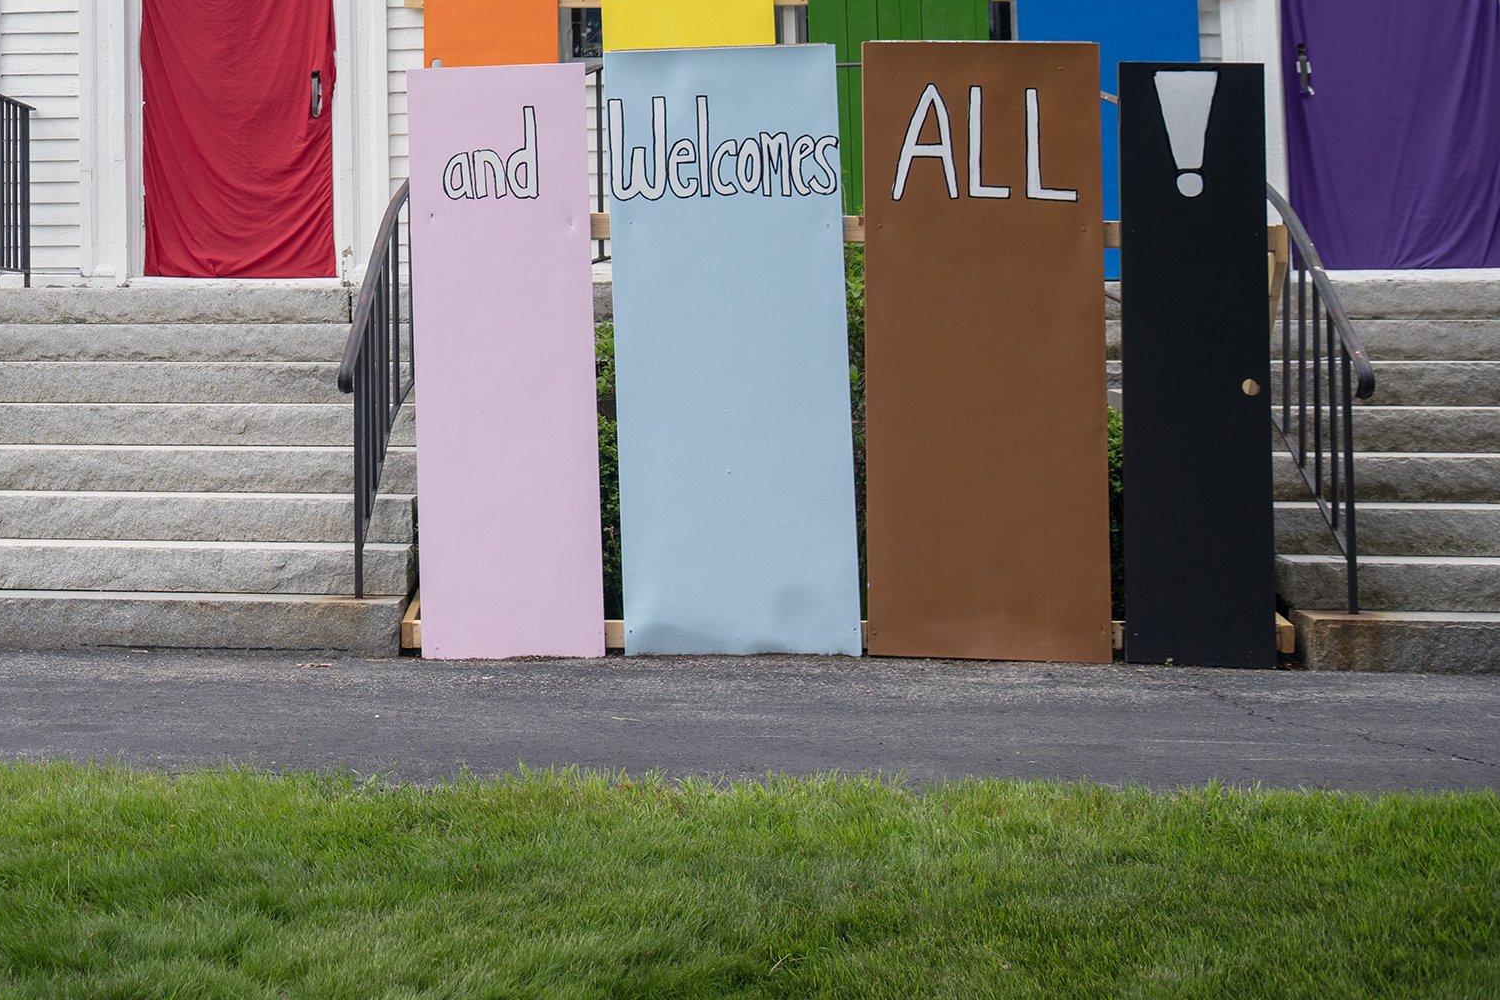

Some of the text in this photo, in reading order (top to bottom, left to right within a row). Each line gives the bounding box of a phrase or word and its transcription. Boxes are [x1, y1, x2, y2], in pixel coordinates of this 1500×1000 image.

[442, 69, 1219, 202] and Welcomes ALL !
